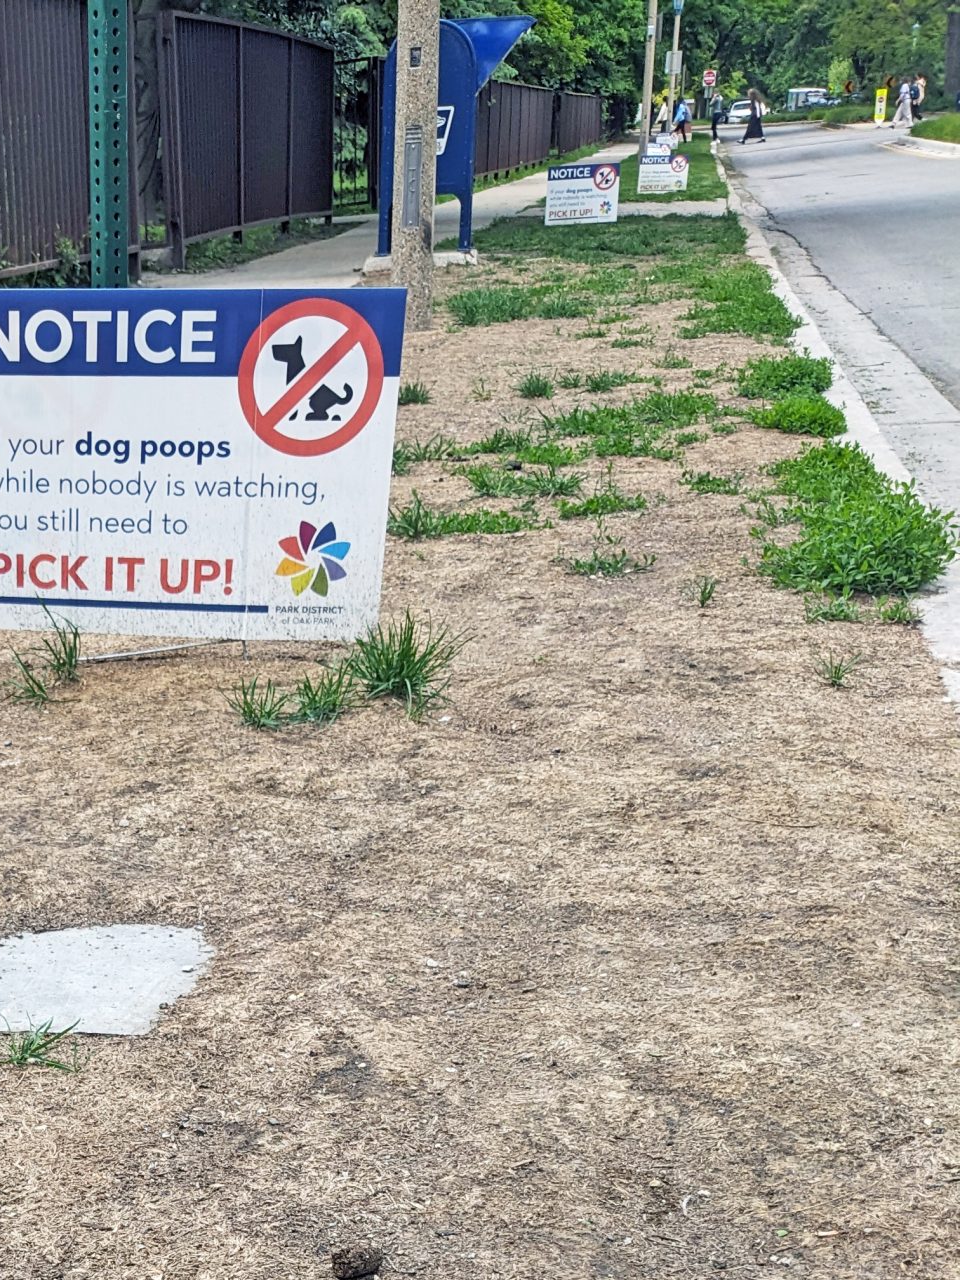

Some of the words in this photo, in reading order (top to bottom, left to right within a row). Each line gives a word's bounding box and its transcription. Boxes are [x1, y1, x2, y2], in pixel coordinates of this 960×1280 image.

[642, 156, 670, 164] NOTICE
[550, 167, 591, 179] NOTICE
[549, 210, 567, 218] PICK
[570, 209, 577, 217] IT
[580, 208, 593, 216] UP!
[8, 438, 64, 462] your
[75, 431, 130, 464] dog
[140, 439, 231, 465] poops
[59, 470, 157, 503] nobody
[166, 474, 185, 496] is
[194, 473, 325, 505] watching,
[37, 508, 79, 531] still
[90, 510, 152, 534] need
[162, 513, 188, 534] to
[104, 556, 145, 592] IT
[159, 558, 234, 596] UP!
[275, 606, 299, 614] PARK
[301, 606, 343, 615] DISTRICT
[281, 617, 290, 625] of
[292, 617, 311, 625] OAK
[313, 617, 335, 625] PARK
